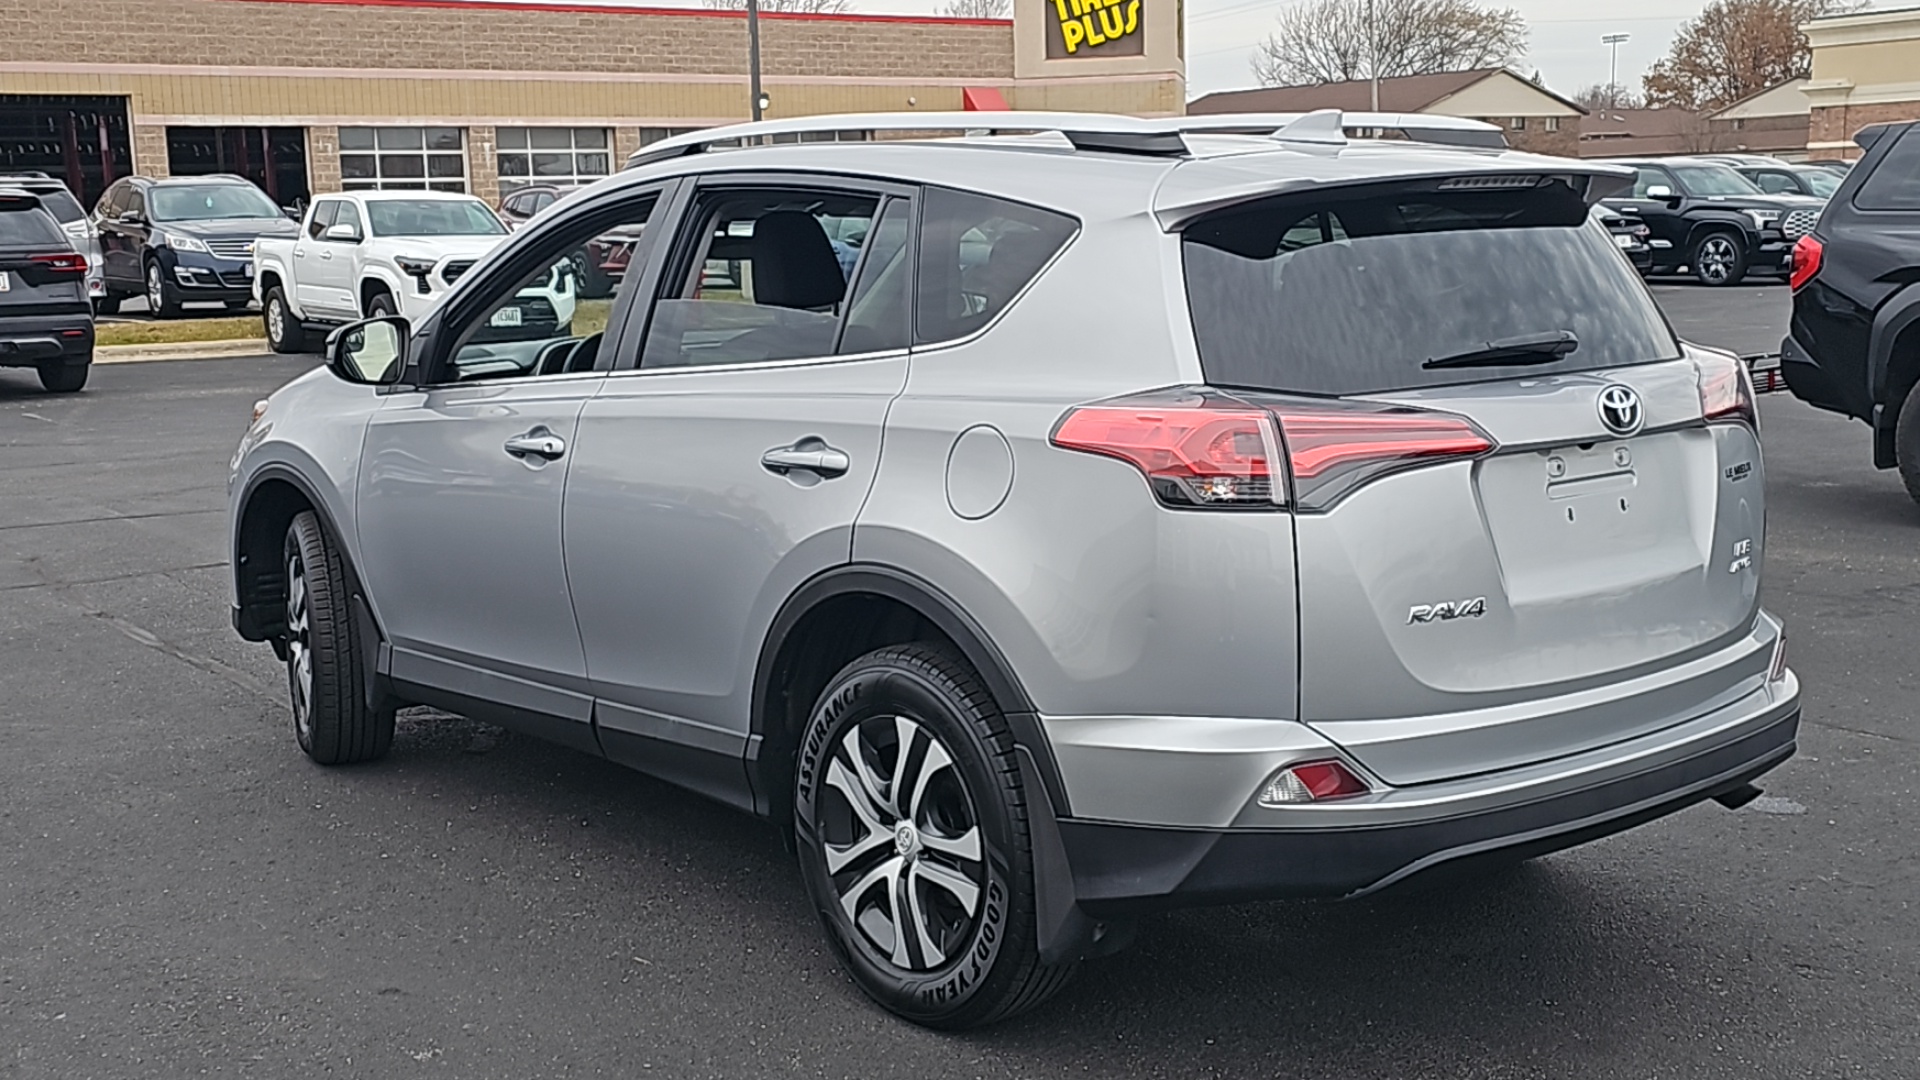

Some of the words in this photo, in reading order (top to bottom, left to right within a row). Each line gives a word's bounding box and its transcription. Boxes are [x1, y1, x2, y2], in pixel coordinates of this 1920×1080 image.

[1060, 0, 1140, 53] PLUS
[1406, 596, 1487, 625] RAV4
[799, 681, 863, 804] ASSURANCE
[921, 879, 1001, 1004] GOODYEAR
